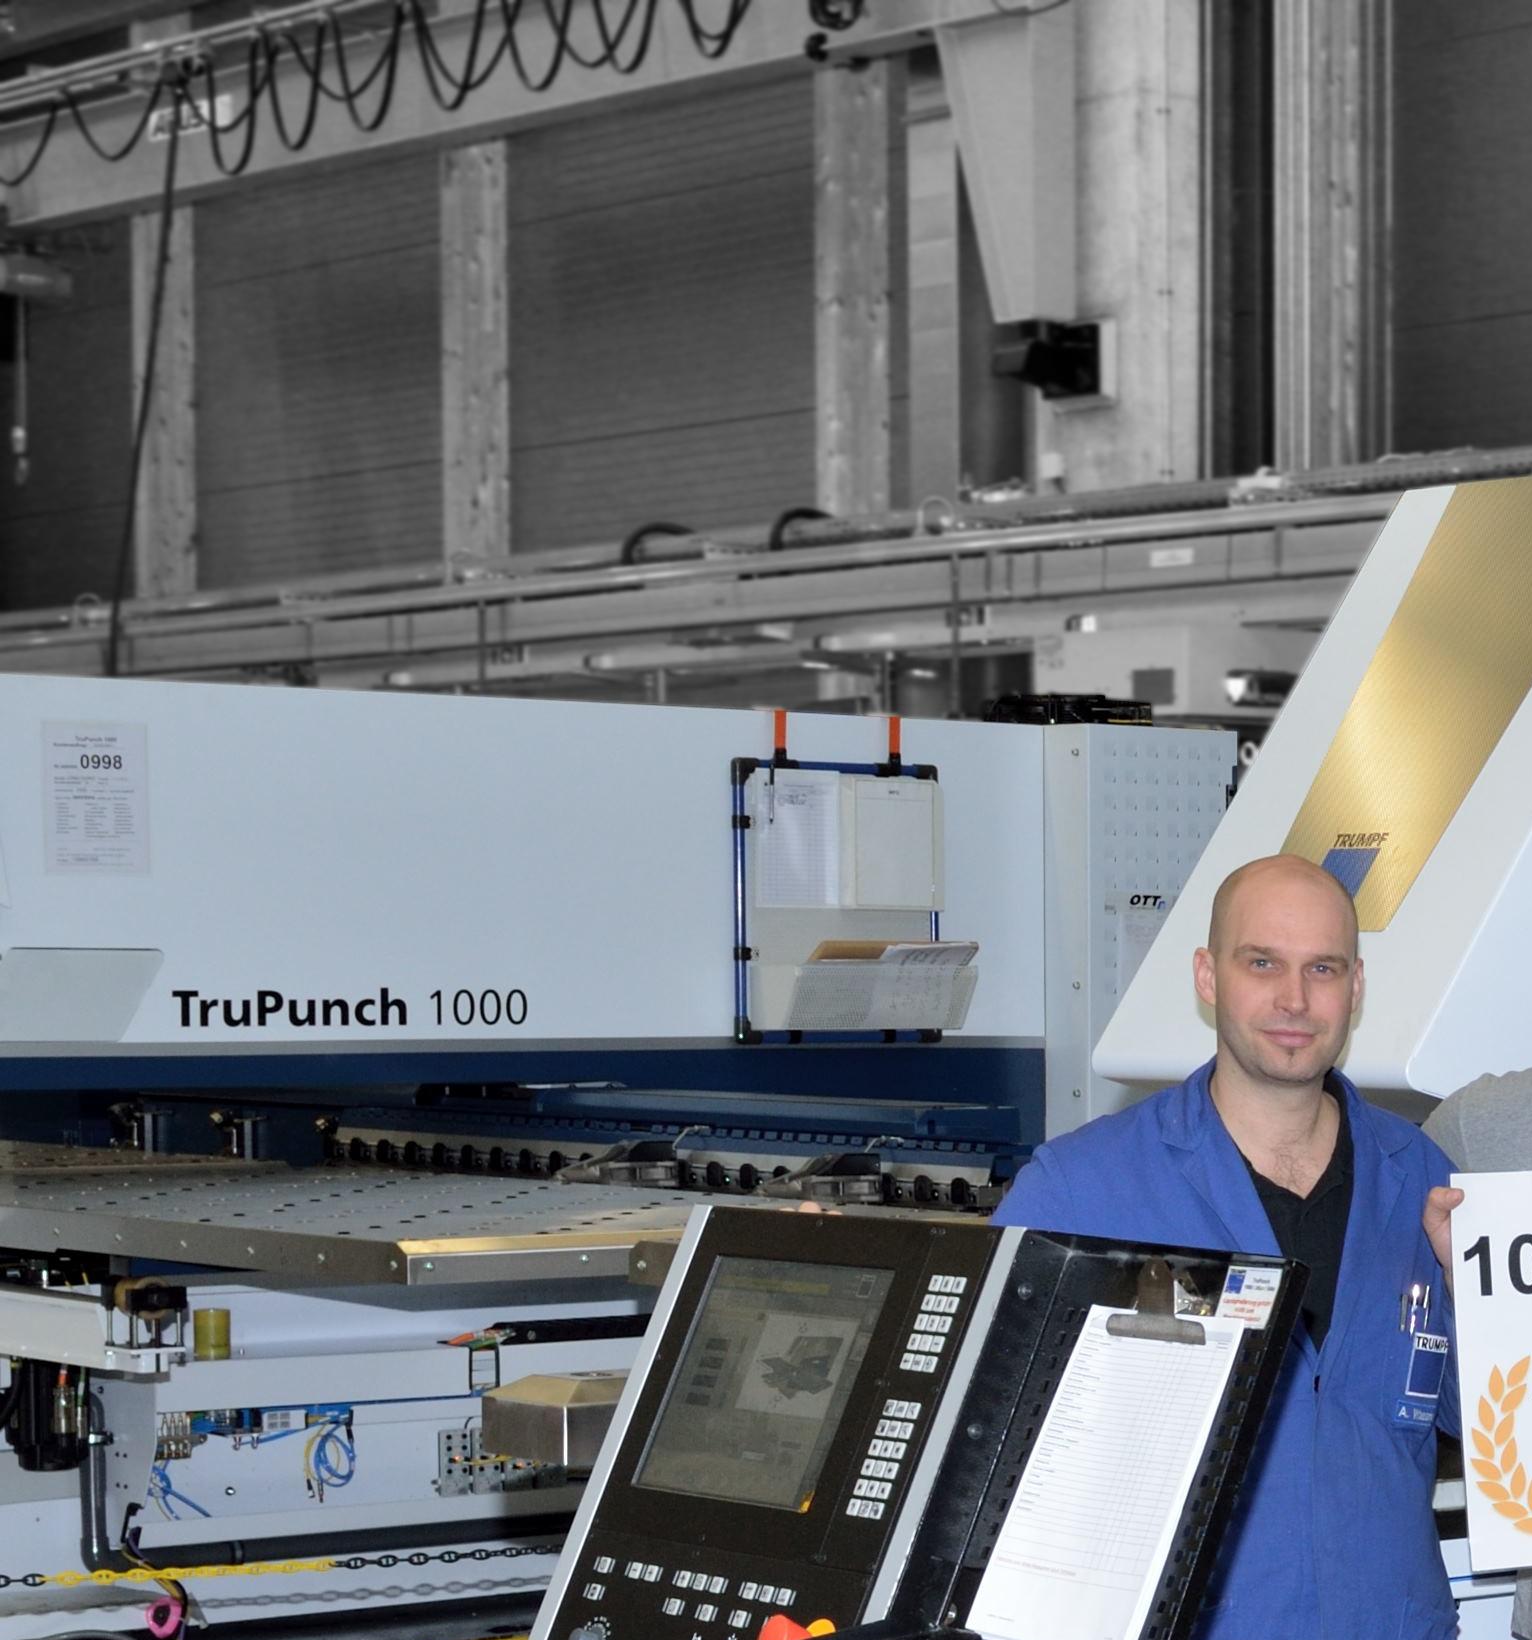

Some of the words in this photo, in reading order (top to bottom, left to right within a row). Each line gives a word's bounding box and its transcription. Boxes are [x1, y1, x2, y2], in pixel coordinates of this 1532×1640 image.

[80, 754, 123, 770] 0998
[1333, 832, 1390, 848] TRUMPF
[172, 988, 409, 1028] TruPunch
[429, 988, 530, 1027] 1000
